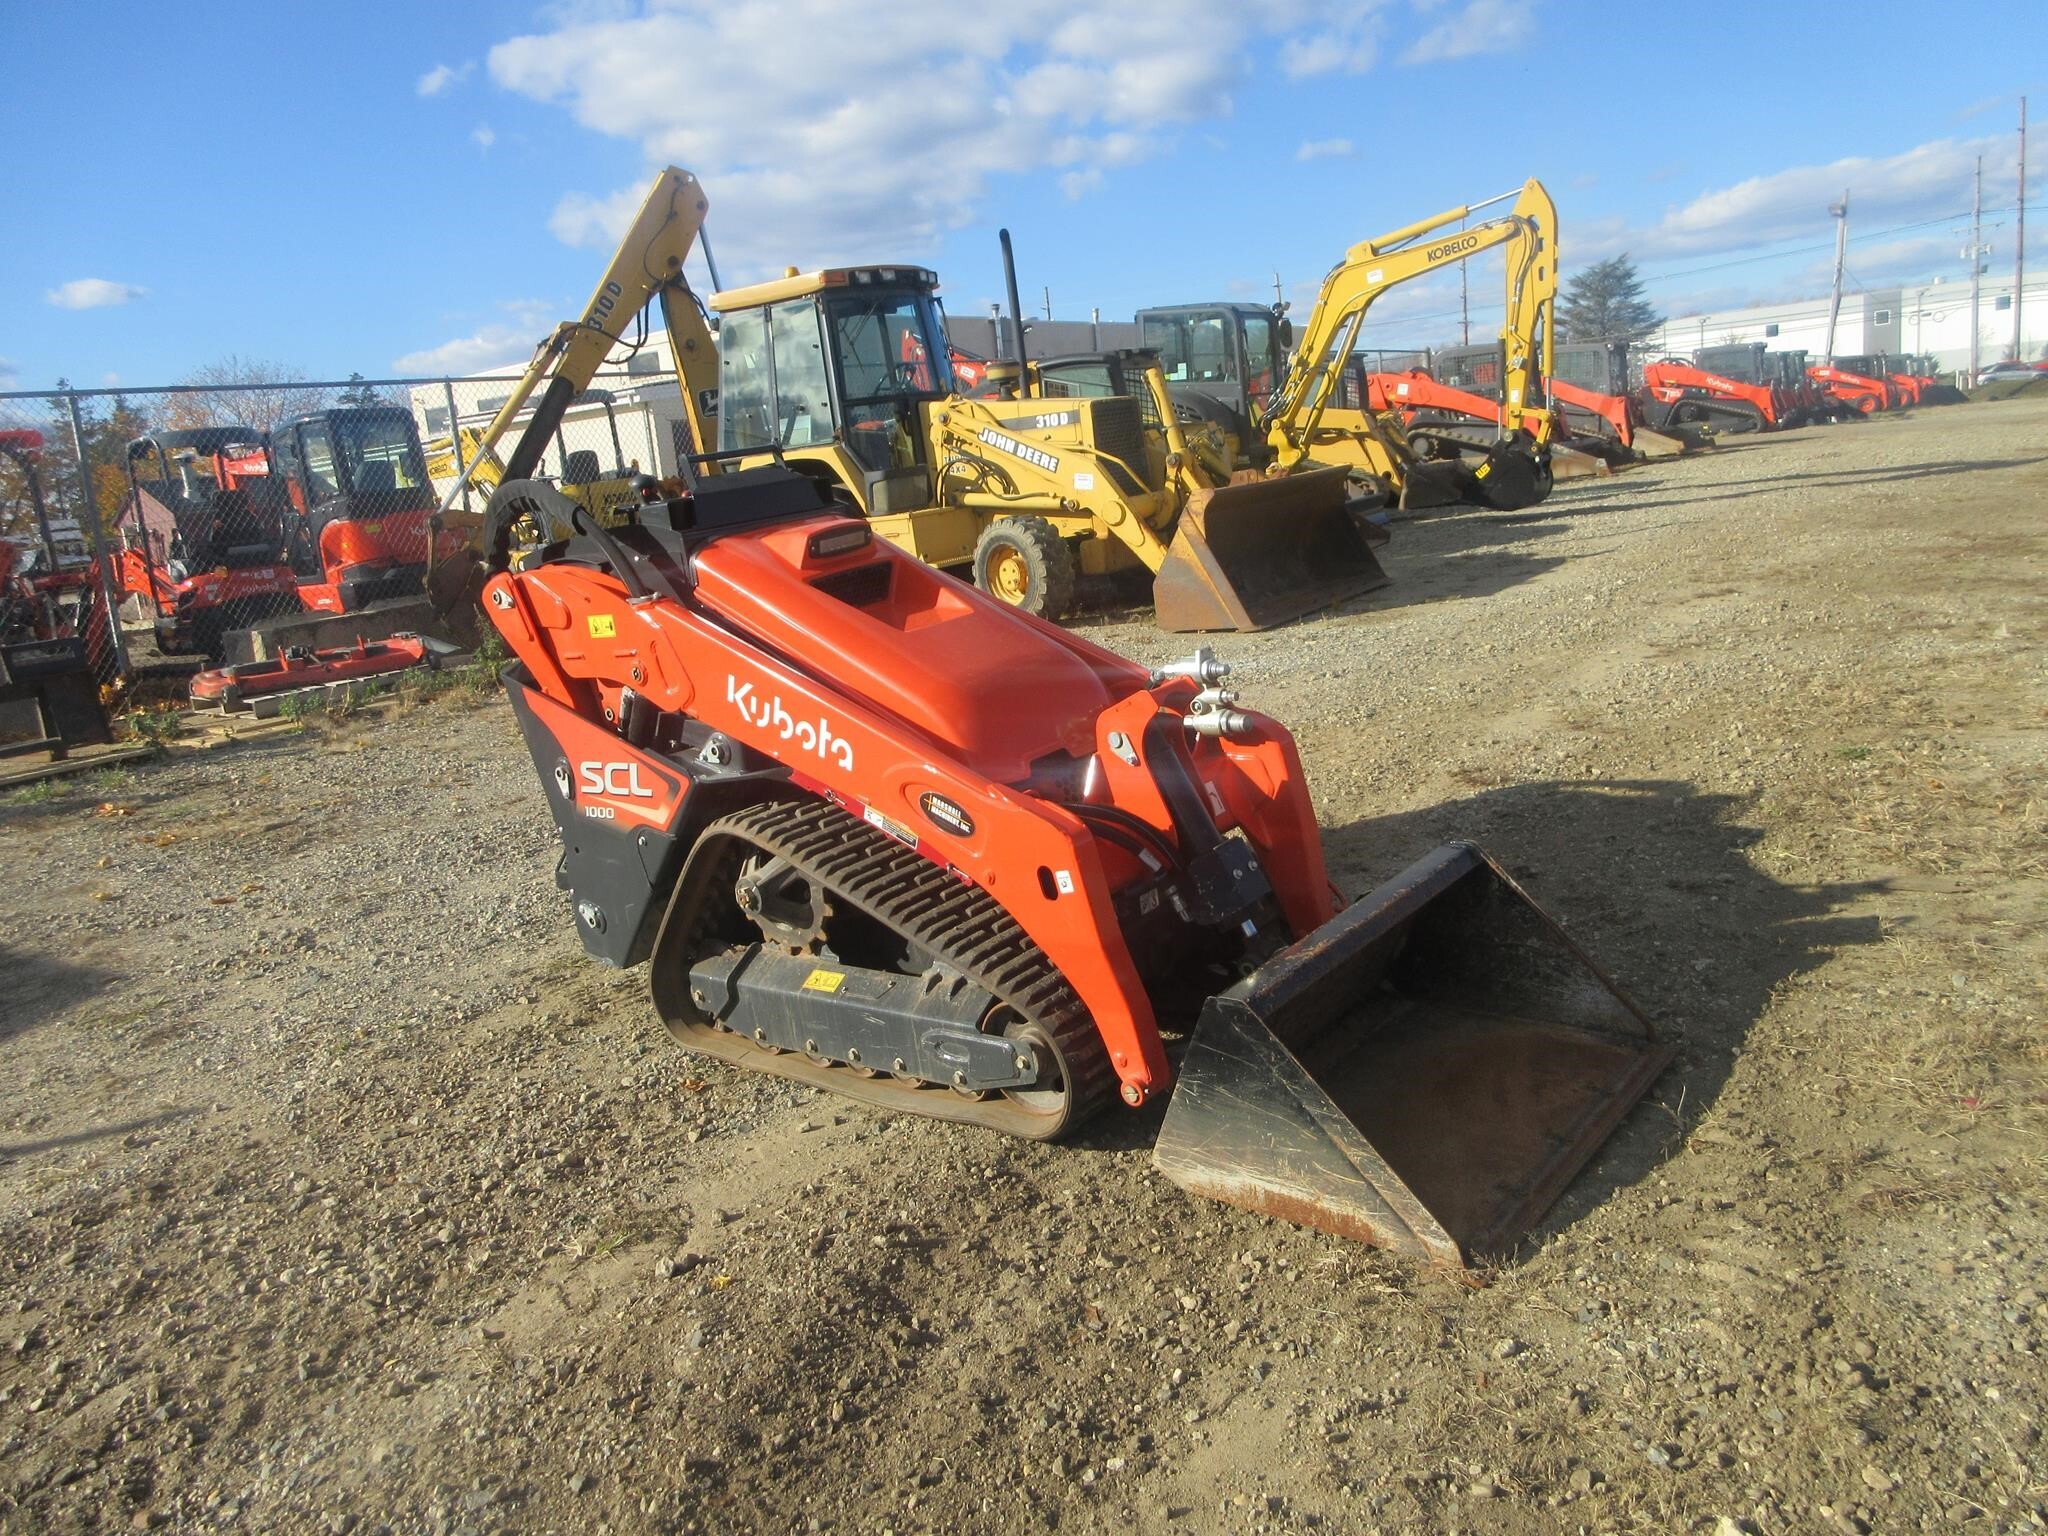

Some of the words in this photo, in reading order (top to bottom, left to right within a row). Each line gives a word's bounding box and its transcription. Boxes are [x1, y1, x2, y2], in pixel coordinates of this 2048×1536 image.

[1426, 235, 1478, 262] KOBELCO
[587, 297, 615, 330] 310
[606, 281, 623, 299] D
[1706, 376, 1734, 391] Kubota
[1035, 413, 1059, 428] 310
[1059, 412, 1069, 425] D
[978, 428, 1016, 452] JOHN
[1016, 443, 1059, 472] DEERE
[950, 465, 966, 474] 4X4
[727, 674, 853, 772] Kubota
[580, 761, 653, 797] SCL
[584, 806, 615, 819] 1000
[932, 796, 961, 817] MARSHALL
